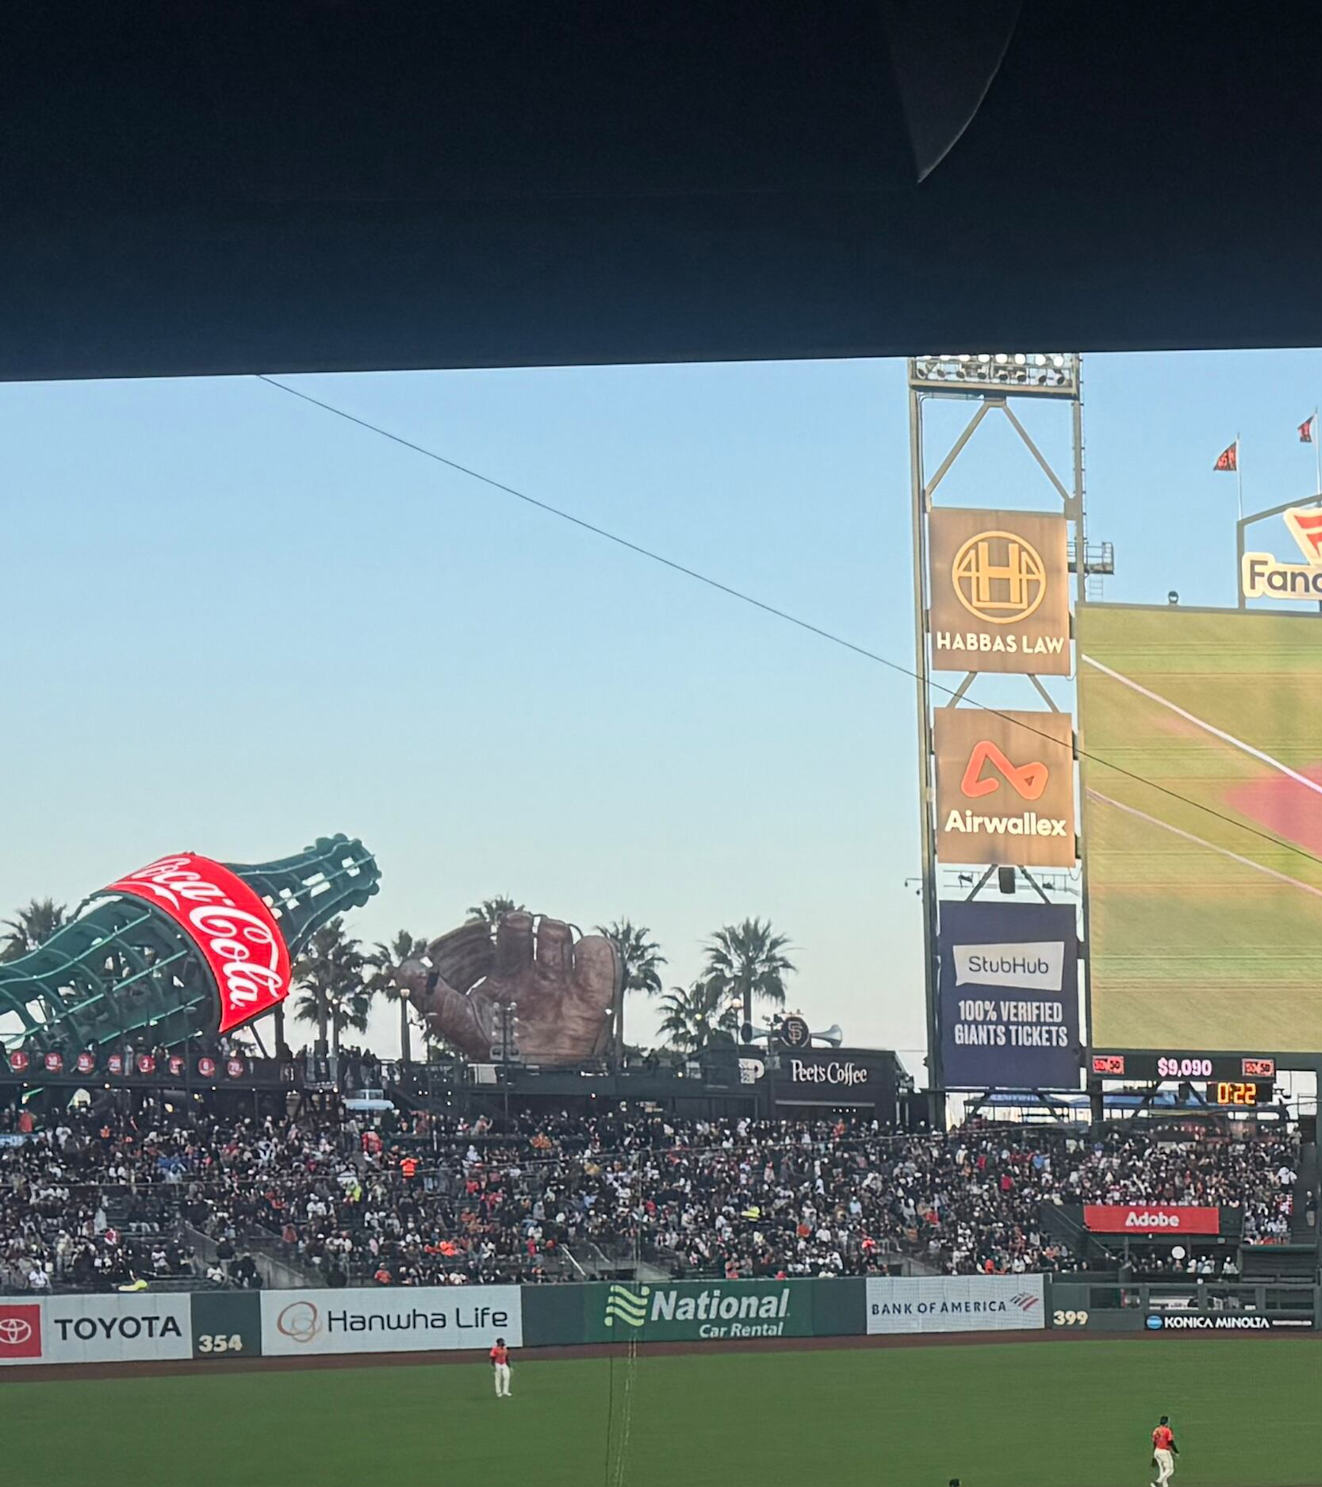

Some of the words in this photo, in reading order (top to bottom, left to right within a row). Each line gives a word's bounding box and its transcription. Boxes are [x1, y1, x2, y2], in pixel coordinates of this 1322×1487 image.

[936, 632, 1017, 654] HABBAS
[1022, 637, 1065, 655] LAW
[945, 810, 1067, 838] Airwallex
[143, 855, 284, 1010] Coca-Cola
[968, 955, 1049, 976] StubHub
[958, 1001, 997, 1022] 100%
[1000, 1001, 1063, 1023] VERIFIED
[955, 1024, 1005, 1046] GIANTS
[1009, 1025, 1068, 1047] TICKETS
[790, 1059, 826, 1082] Peet's
[827, 1062, 867, 1086] Coffee
[1158, 1059, 1212, 1077] $9,090
[1217, 1082, 1257, 1105] 0:22
[1125, 1211, 1179, 1227] Adobe
[651, 1287, 789, 1321] National
[872, 1303, 913, 1316] BANK
[917, 1302, 936, 1314] OF
[940, 1300, 1006, 1313] AMERICA
[54, 1315, 182, 1340] TOYOTA
[328, 1309, 448, 1332] Hanwha
[456, 1307, 509, 1329] Life
[700, 1324, 727, 1336] Car
[730, 1322, 783, 1336] Rental
[1053, 1310, 1088, 1326] 399
[1165, 1317, 1213, 1328] KONICA
[1215, 1317, 1269, 1328] MINOLTA
[199, 1334, 242, 1353] 354
